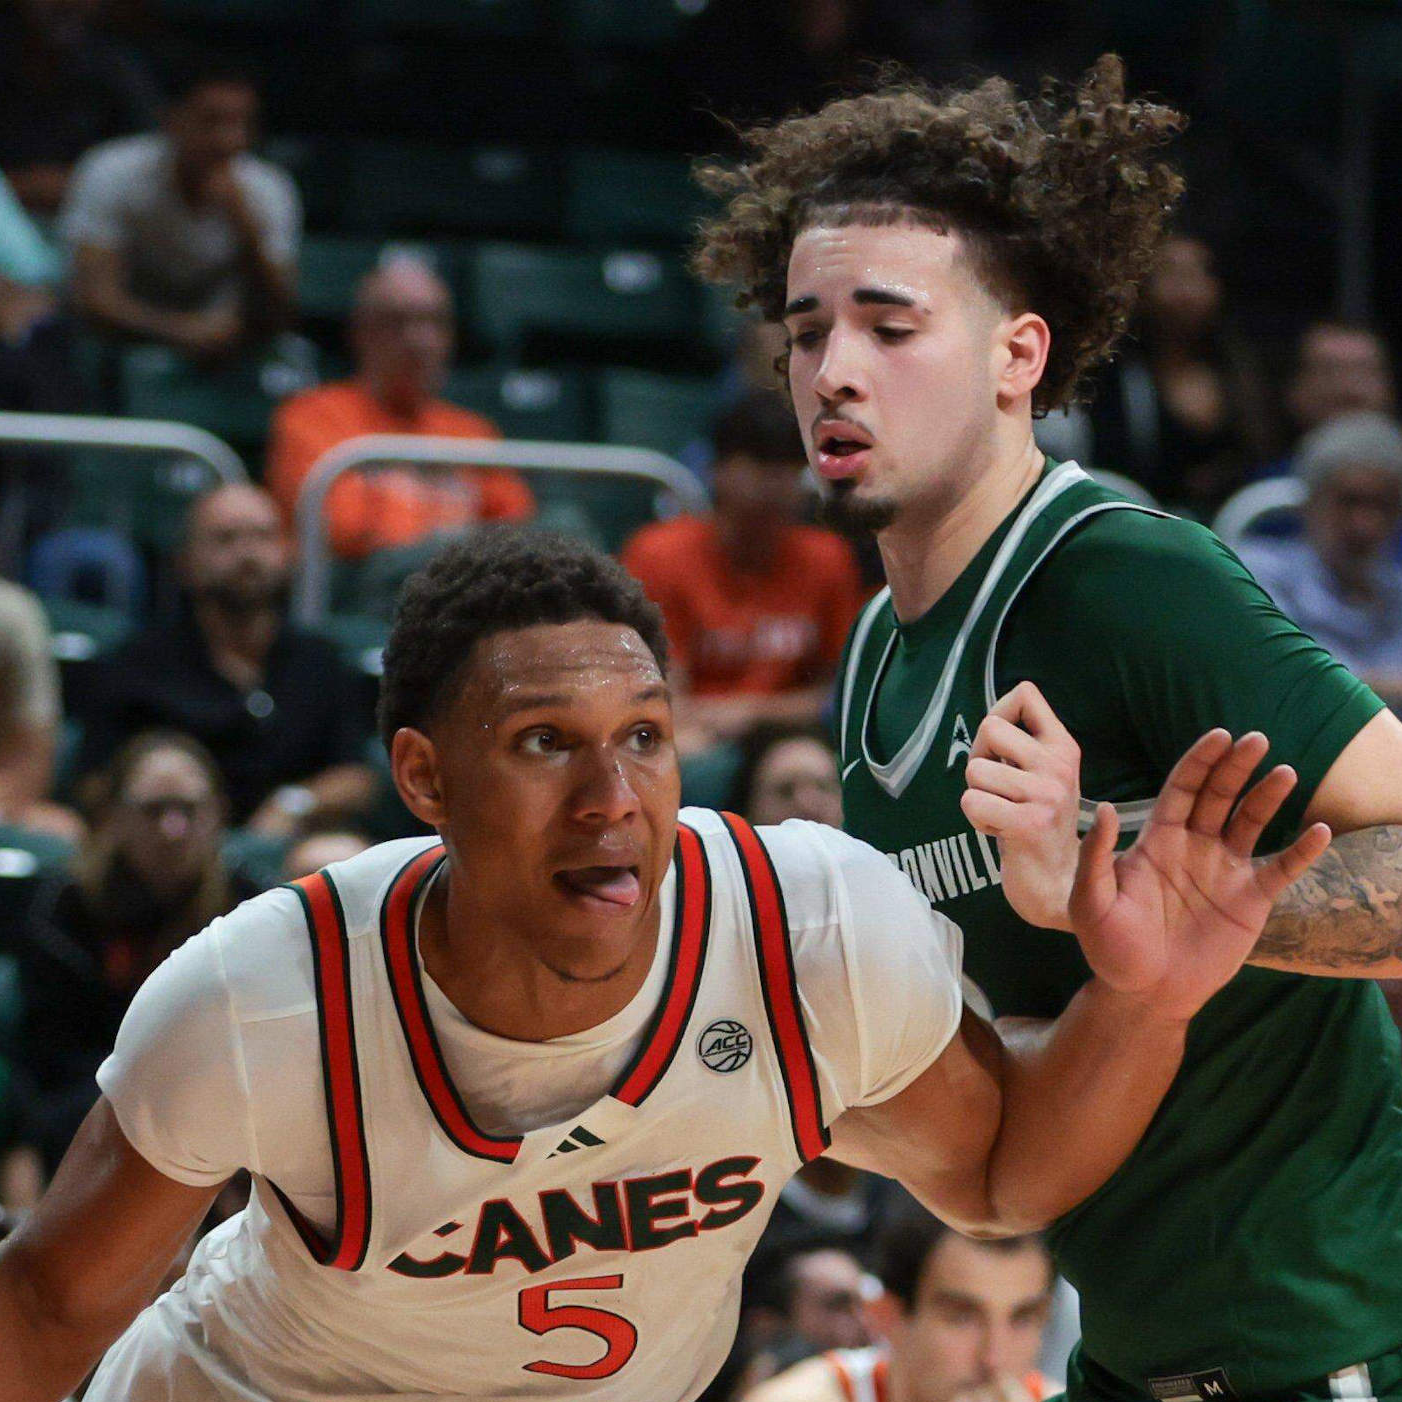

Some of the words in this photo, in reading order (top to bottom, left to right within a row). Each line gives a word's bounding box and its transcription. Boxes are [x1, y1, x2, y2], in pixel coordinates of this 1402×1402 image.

[886, 832, 1002, 903] ONVILL
[705, 1032, 748, 1053] ACC
[386, 1155, 766, 1279] CANES
[517, 1273, 639, 1380] 5
[1204, 1380, 1224, 1396] M
